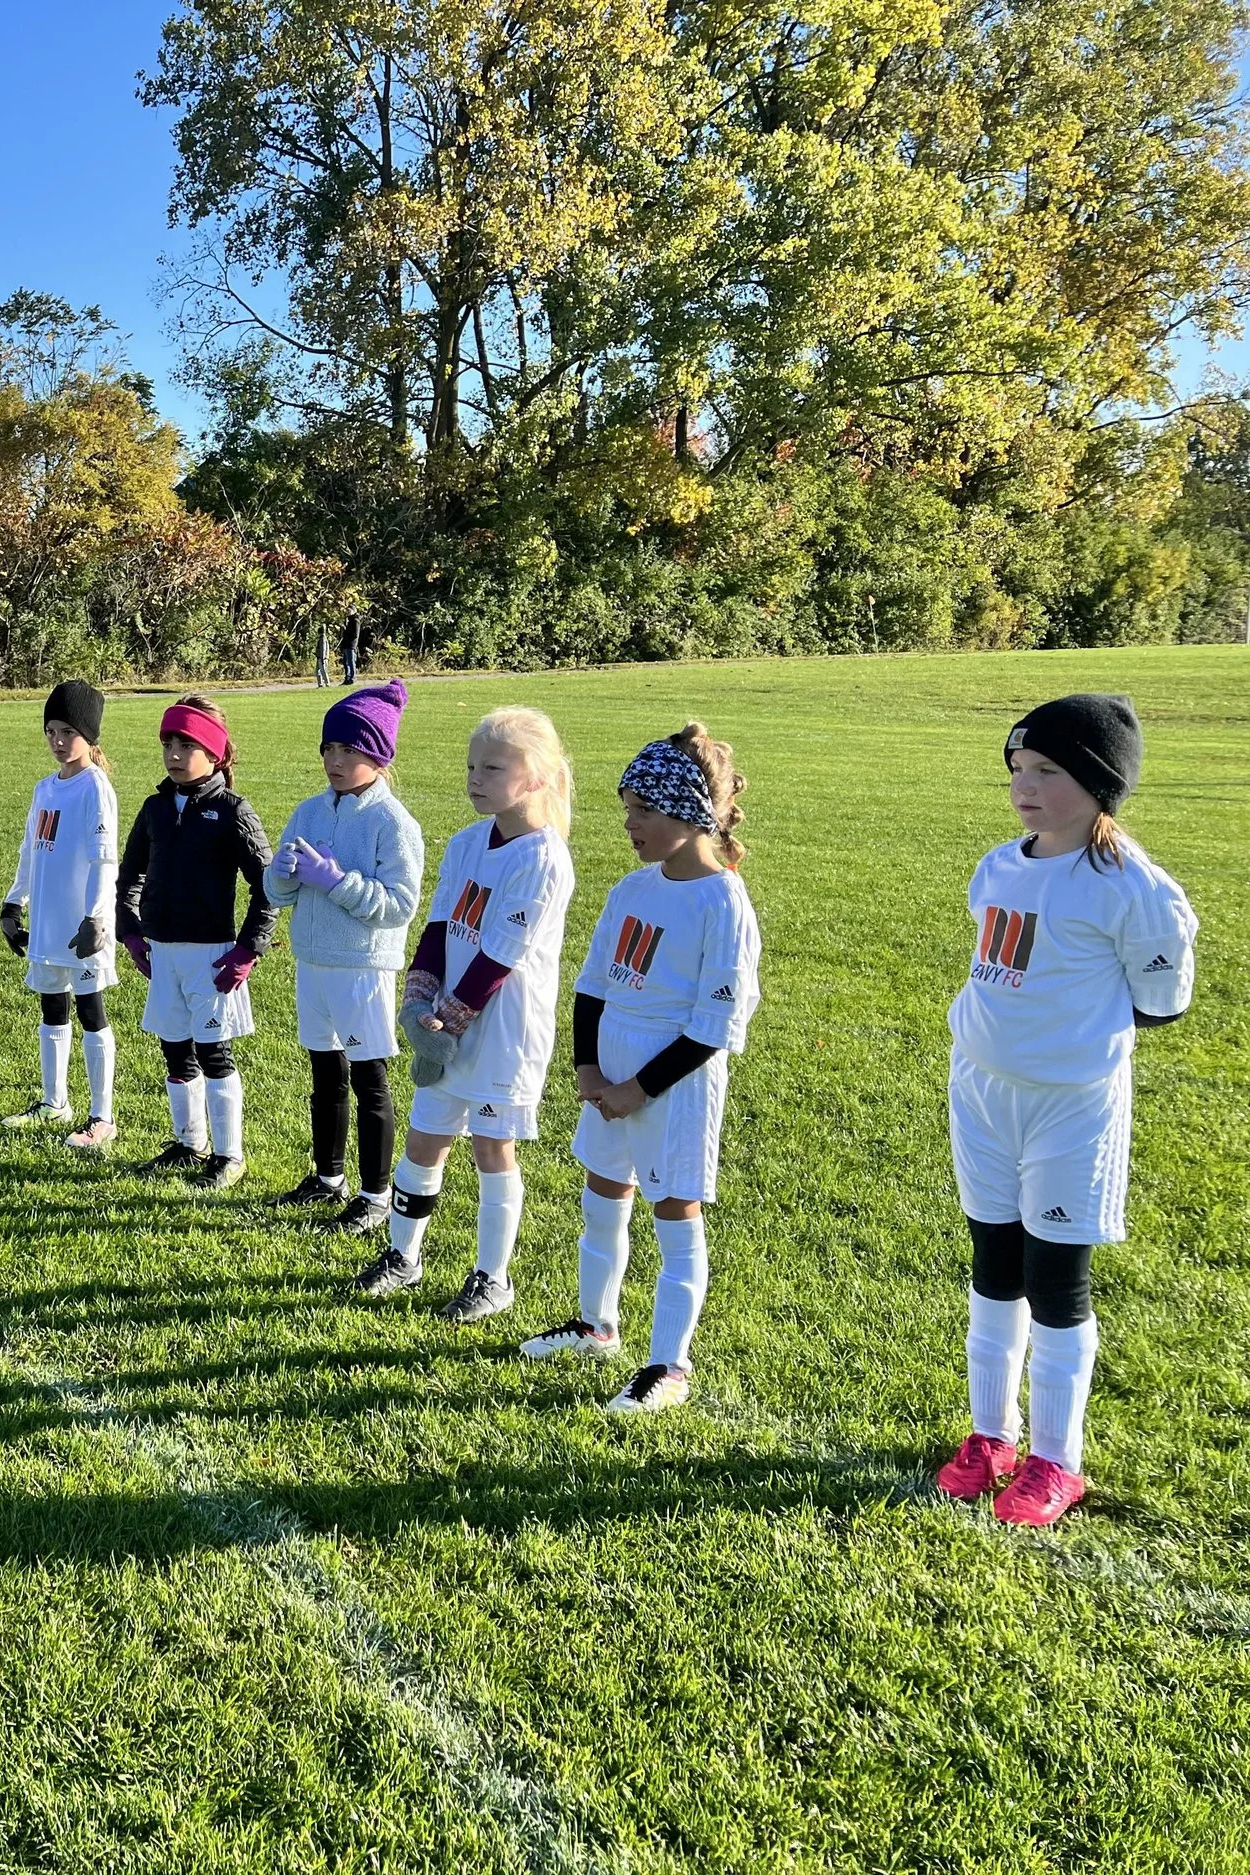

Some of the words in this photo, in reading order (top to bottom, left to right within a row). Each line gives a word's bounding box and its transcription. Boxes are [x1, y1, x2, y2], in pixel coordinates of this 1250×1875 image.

[45, 841, 54, 852] FC
[506, 916, 528, 928] adidas
[449, 920, 467, 940] ENVY
[467, 930, 480, 946] FC
[1142, 964, 1174, 973] adidas
[608, 962, 632, 984] ENVY
[629, 973, 645, 991] FC
[971, 963, 1004, 984] ENVY
[1001, 970, 1024, 988] FC
[1041, 1213, 1072, 1223] adidas
